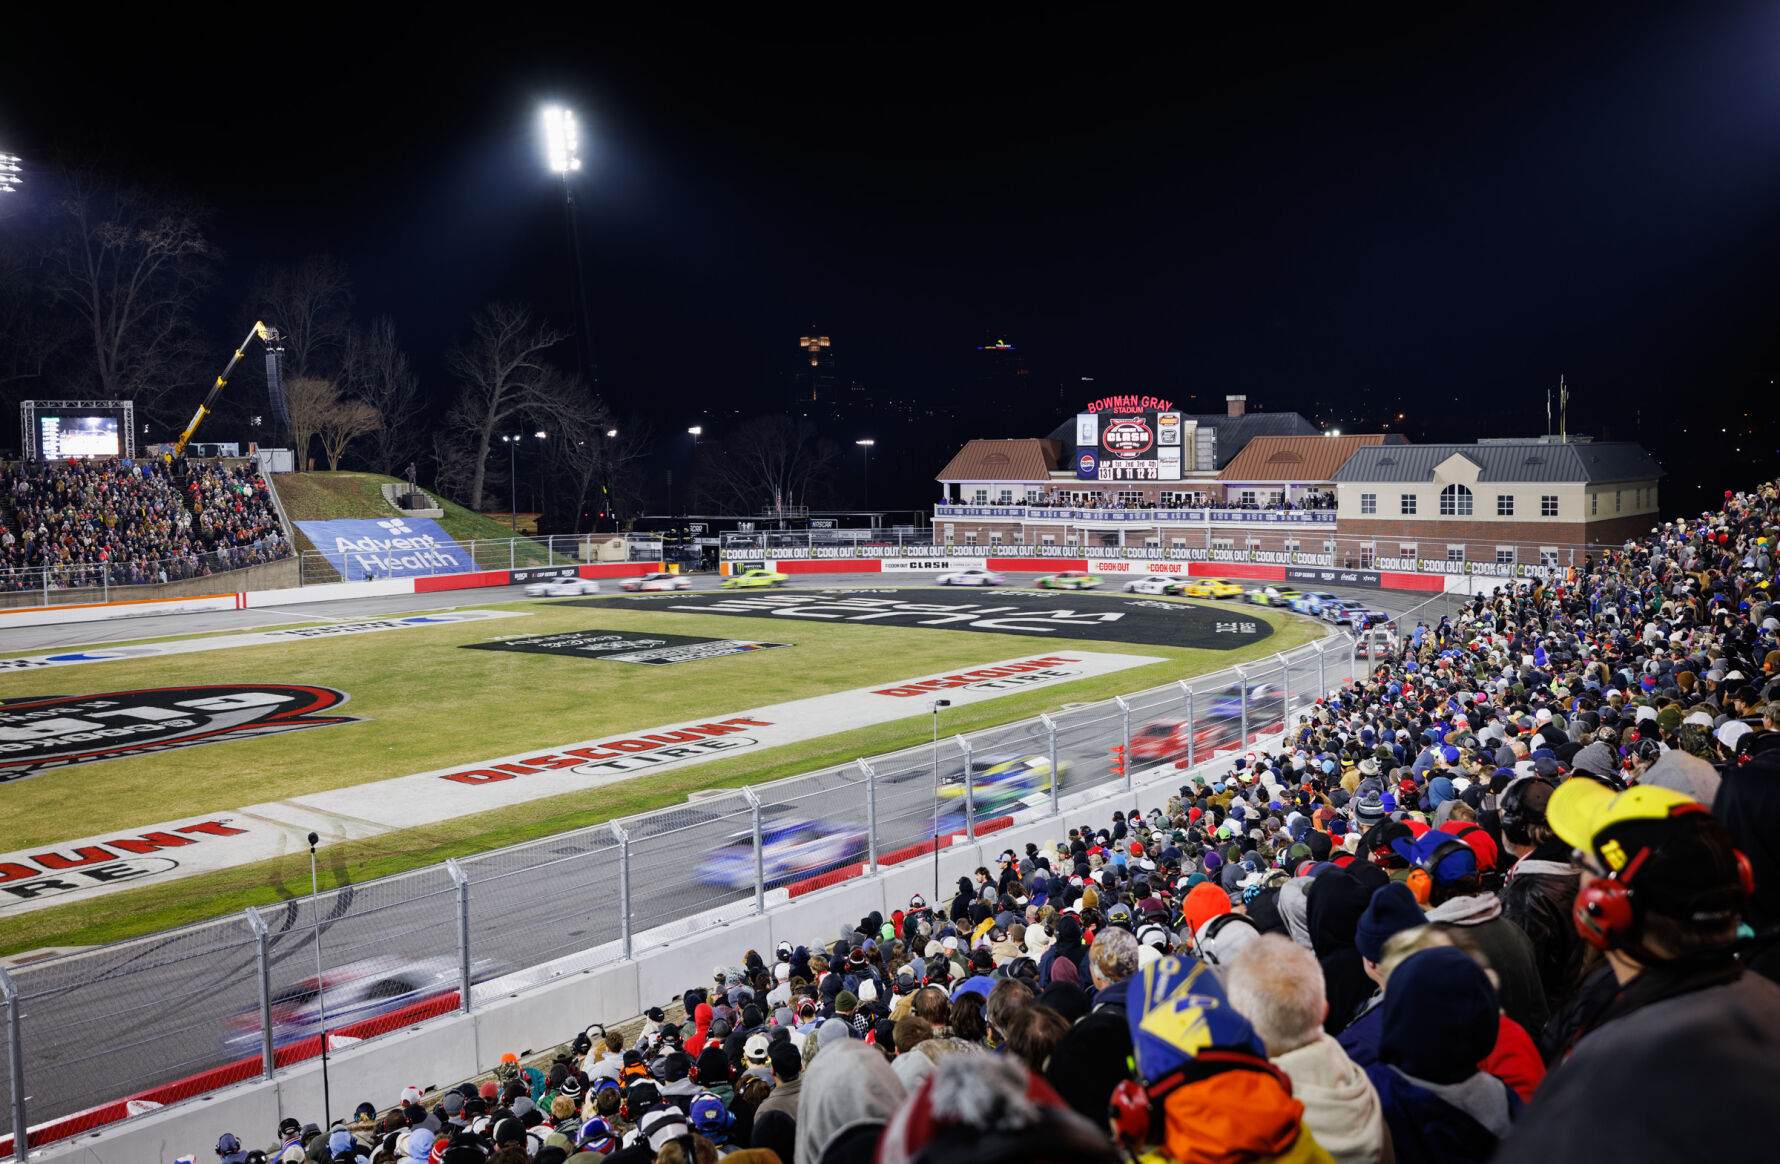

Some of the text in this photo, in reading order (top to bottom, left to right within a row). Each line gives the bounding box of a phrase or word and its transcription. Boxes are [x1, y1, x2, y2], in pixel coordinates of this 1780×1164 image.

[1088, 395, 1173, 414] BOWMAN GRAY
[1107, 432, 1149, 442] CLASH
[1100, 460, 1110, 468] LAP
[1100, 468, 1157, 479] 131 9 11 12 23
[812, 520, 832, 528] NASCAR
[336, 534, 442, 552] Advent
[727, 550, 764, 559] COOK OUT
[772, 548, 809, 558] COOK OUT
[818, 547, 855, 558] COOK OUT
[862, 547, 899, 556] COOK OUT
[908, 546, 944, 556] COOK OUT
[953, 546, 989, 556] COOK OUT
[998, 546, 1034, 556] COOK OUT
[1042, 546, 1077, 556] COOK OUT
[1085, 547, 1120, 558] COOK OUT
[1128, 548, 1162, 558] COOK OUT
[1171, 549, 1207, 559] COOK OUT
[1214, 550, 1249, 561] COOK OUT
[355, 551, 460, 571] Health
[1256, 552, 1290, 563] COOK OUT
[1298, 552, 1332, 565] COOK OUT
[1099, 563, 1130, 571] COOK OUT
[1150, 564, 1181, 572] COOK OUT
[1381, 558, 1415, 570] COOK OUT
[1424, 560, 1462, 573] COOK OUT
[1472, 562, 1496, 575] COOK
[762, 594, 1126, 622] WIPES
[870, 657, 1082, 697] DISCOUNT
[976, 670, 1071, 689] TIRE
[24, 724, 166, 747] COOK
[440, 718, 775, 785] DISCOUNT
[588, 740, 738, 770] TIRE
